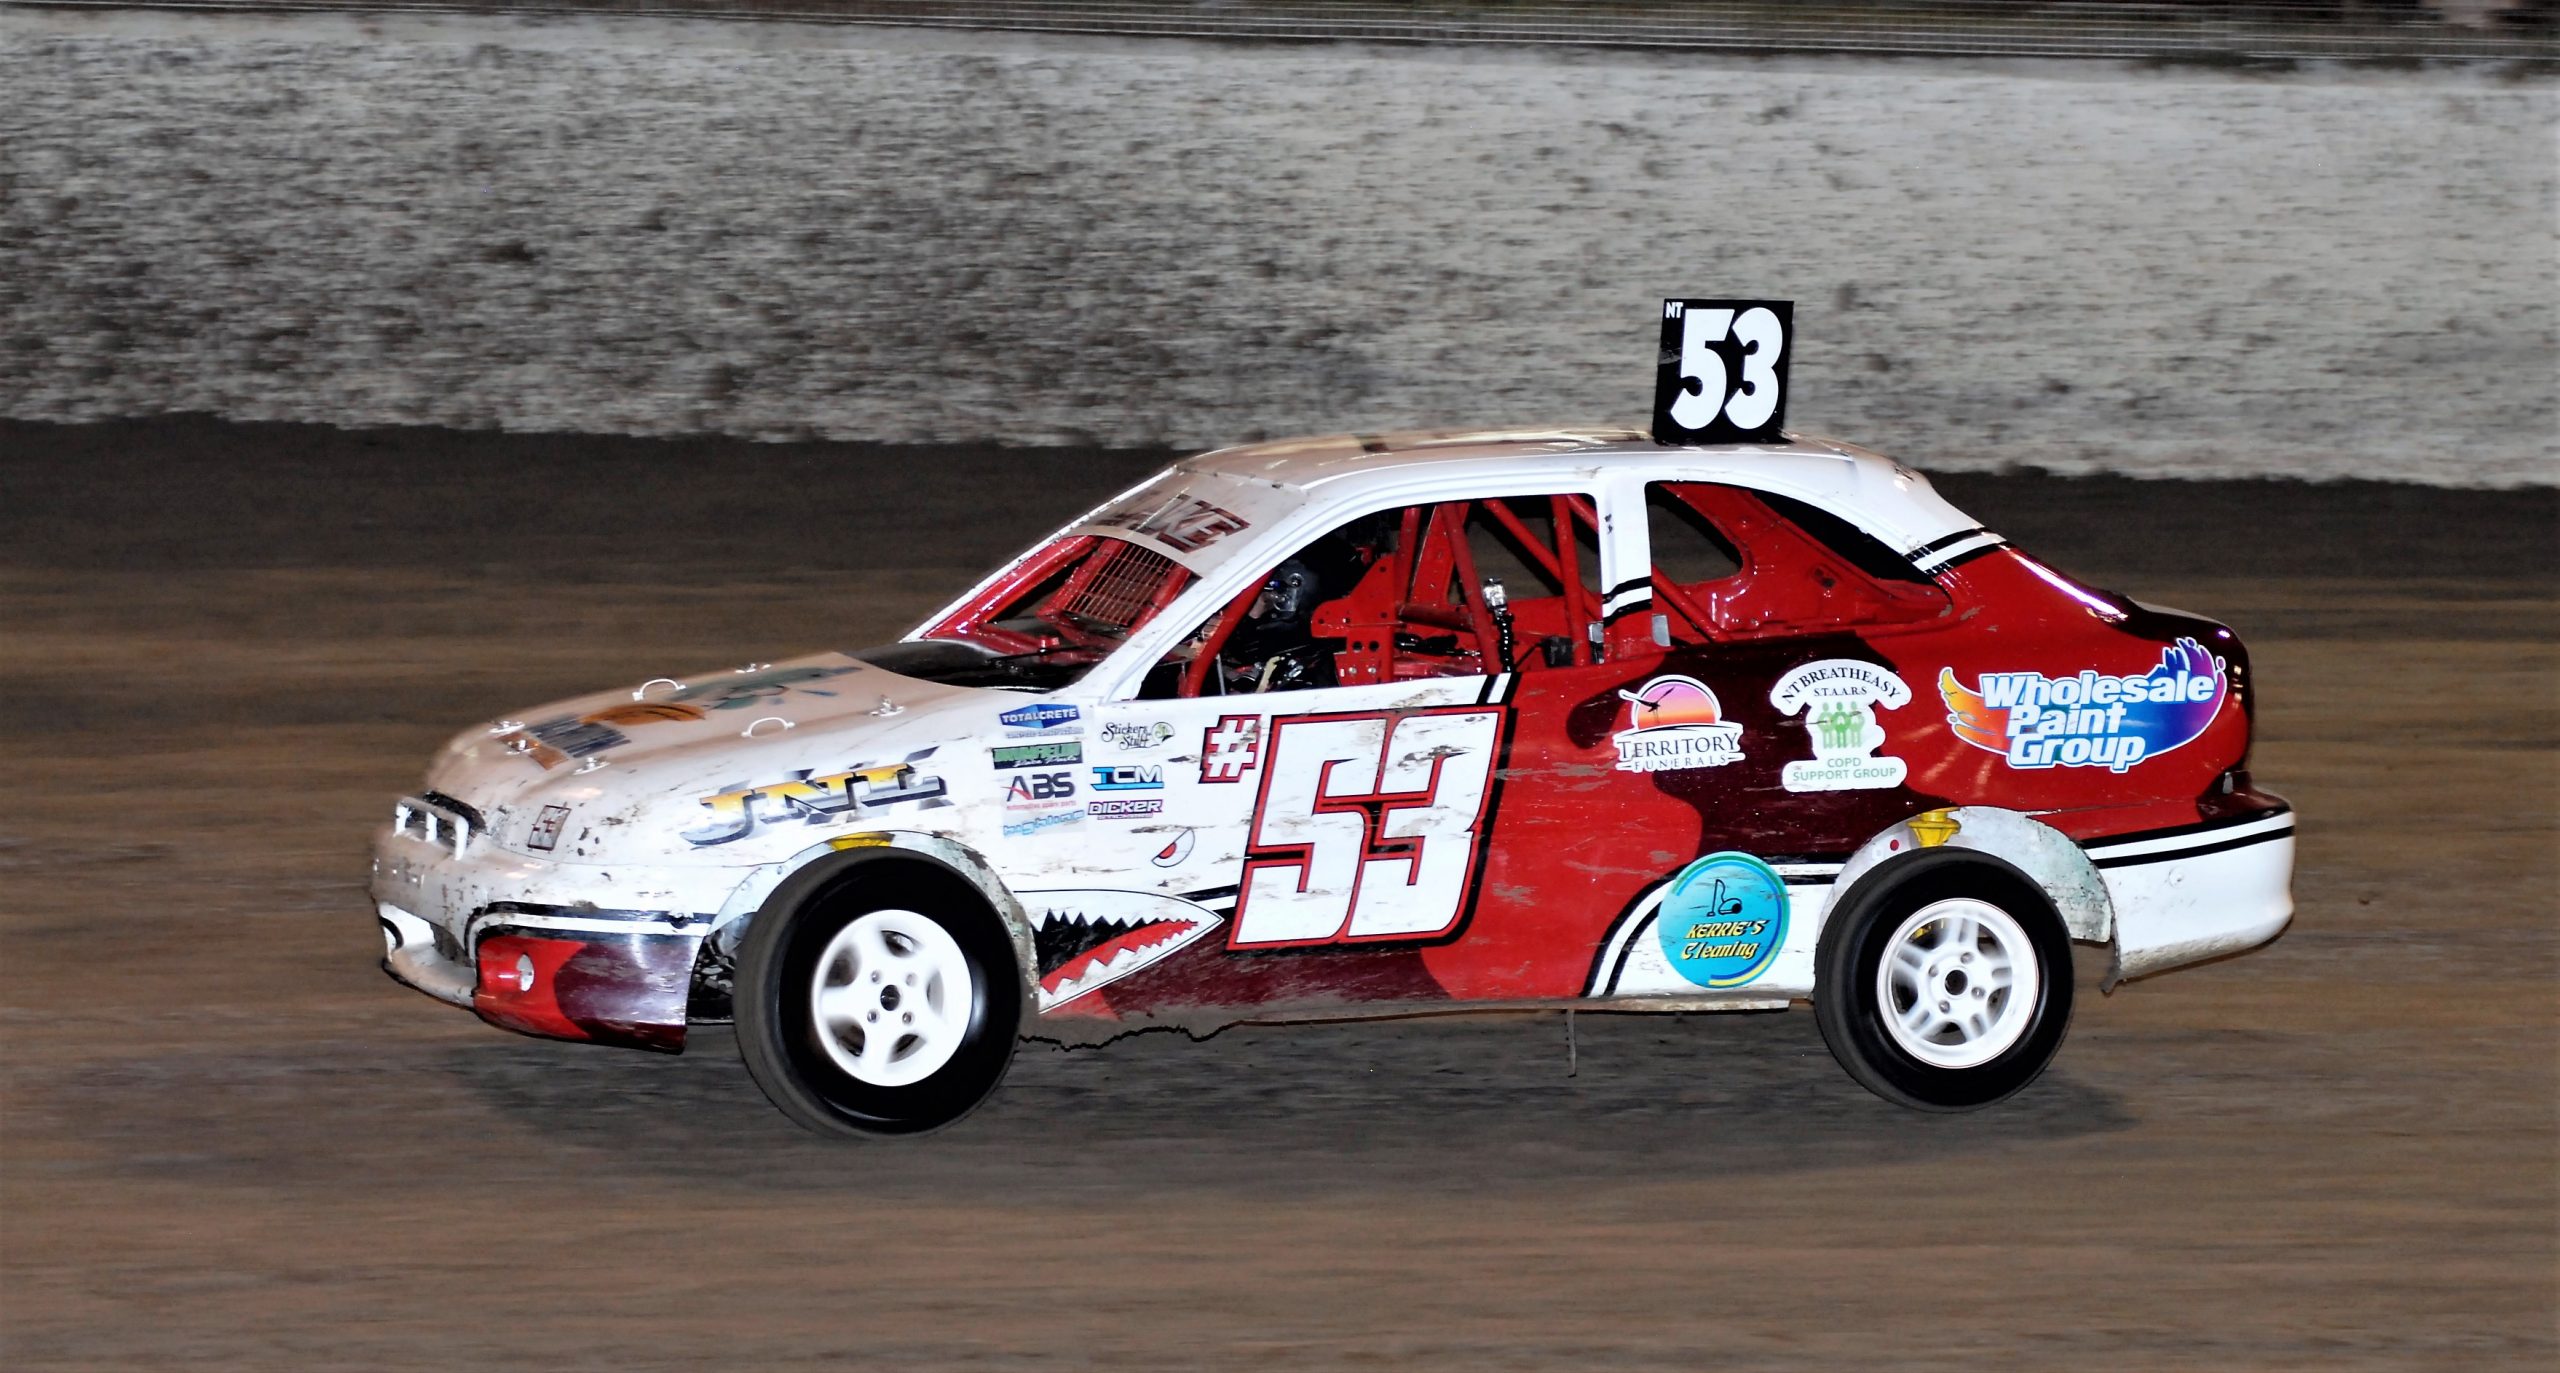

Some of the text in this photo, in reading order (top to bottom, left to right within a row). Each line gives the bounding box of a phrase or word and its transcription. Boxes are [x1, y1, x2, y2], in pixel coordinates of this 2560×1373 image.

[1665, 302, 1683, 318] NT
[1670, 307, 1783, 429] 53
[1982, 671, 2216, 708] Wholesale
[1001, 708, 1077, 723] TOTALCRETE
[2006, 701, 2127, 736] Paint
[1617, 732, 1738, 760] TERRITORY
[2009, 734, 2146, 769] Group
[1634, 755, 1727, 771] FUNERALS
[1827, 758, 1861, 768] COPD
[1793, 767, 1897, 781] SUPPORT GROUP
[1001, 772, 1075, 802] ABS
[1684, 920, 1770, 939] KERRIE'S
[1680, 941, 1760, 961] Cleaning
